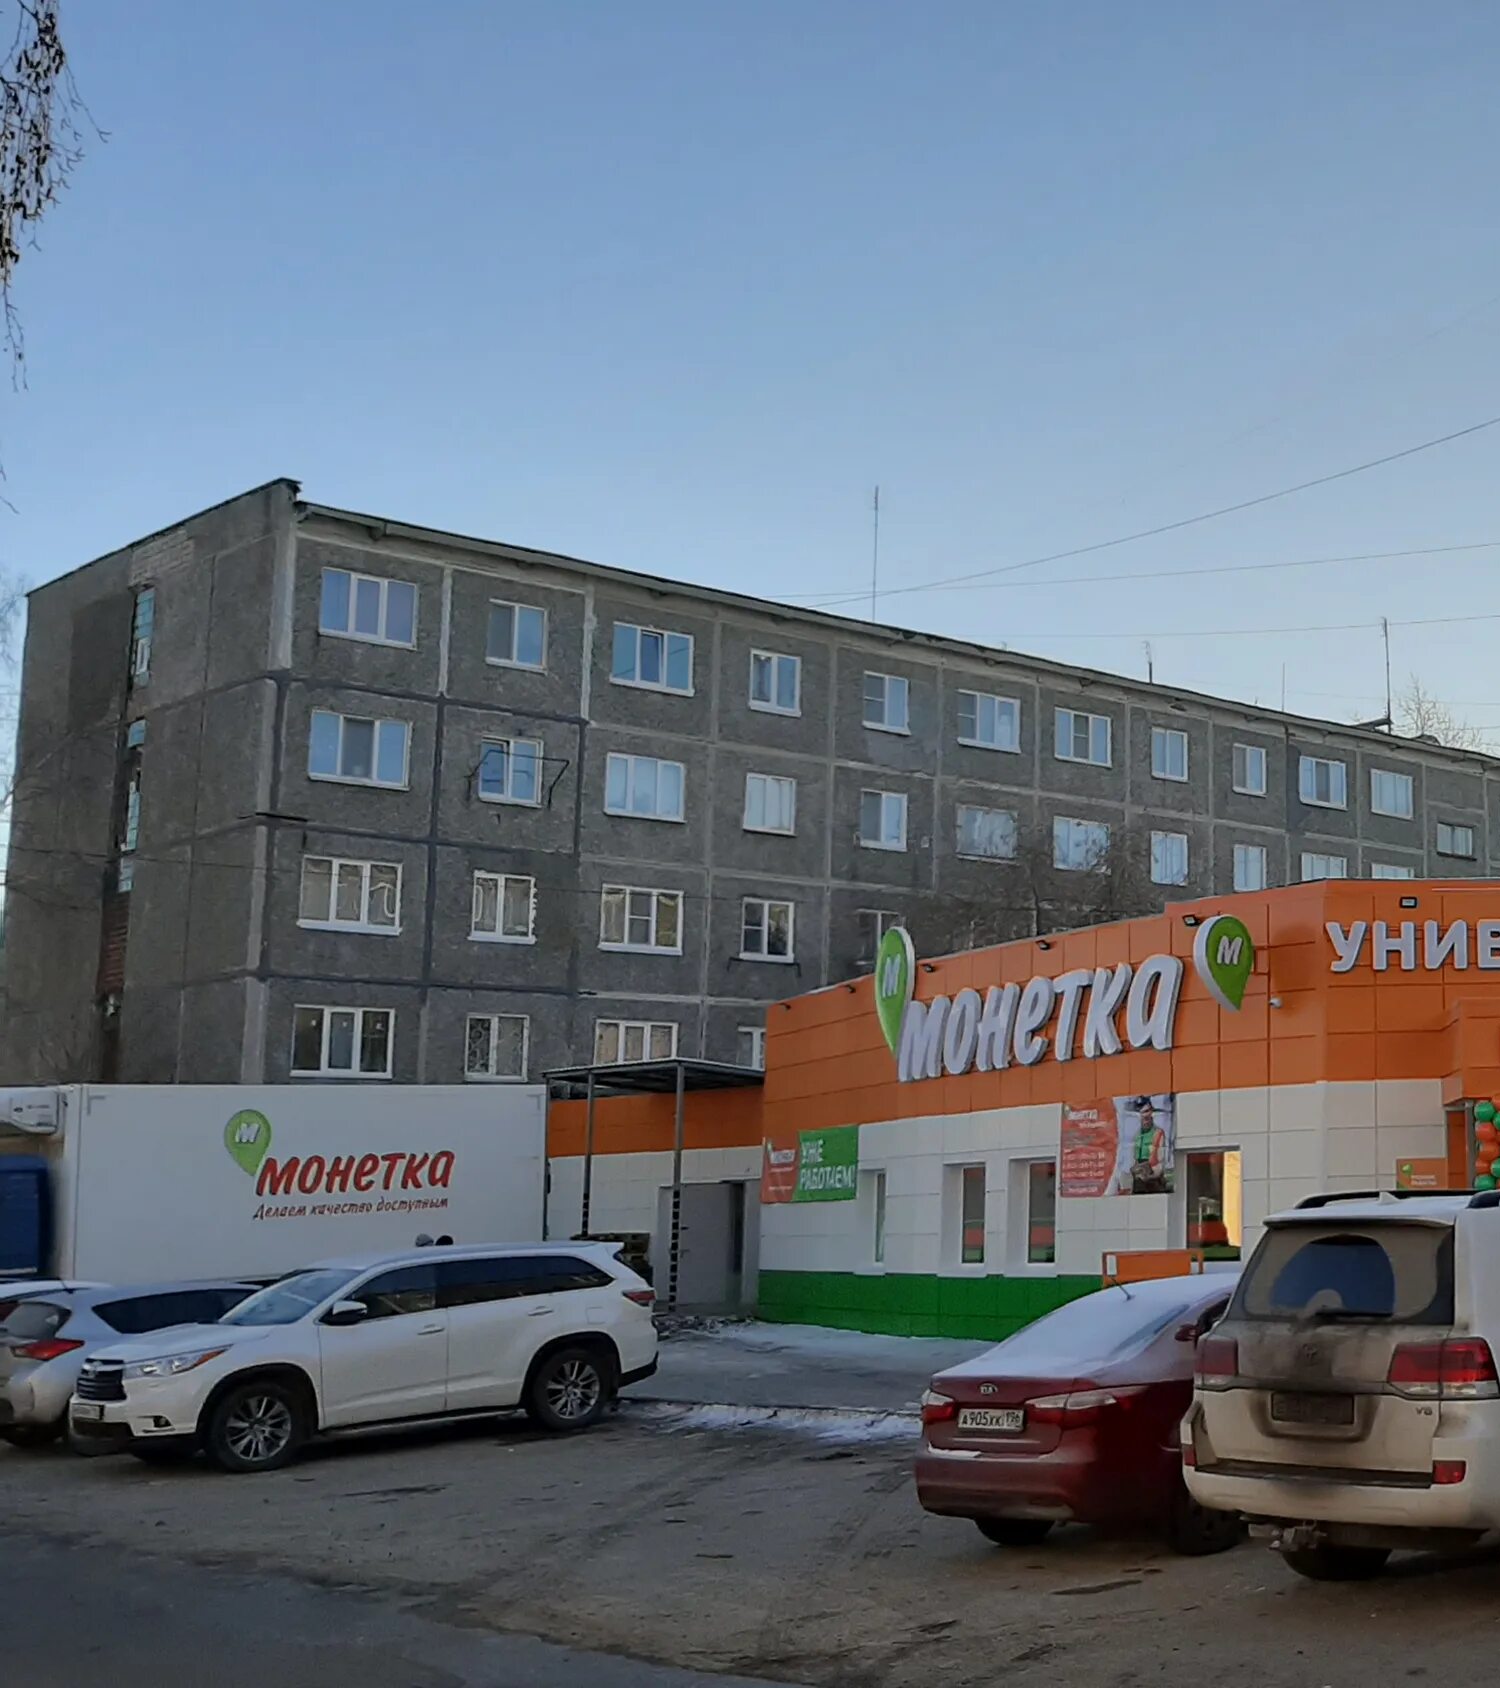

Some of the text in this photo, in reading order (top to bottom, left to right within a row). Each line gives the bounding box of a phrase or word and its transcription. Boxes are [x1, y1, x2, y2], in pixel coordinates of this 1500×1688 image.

[253, 1196, 448, 1220] Делаем качество доступным
